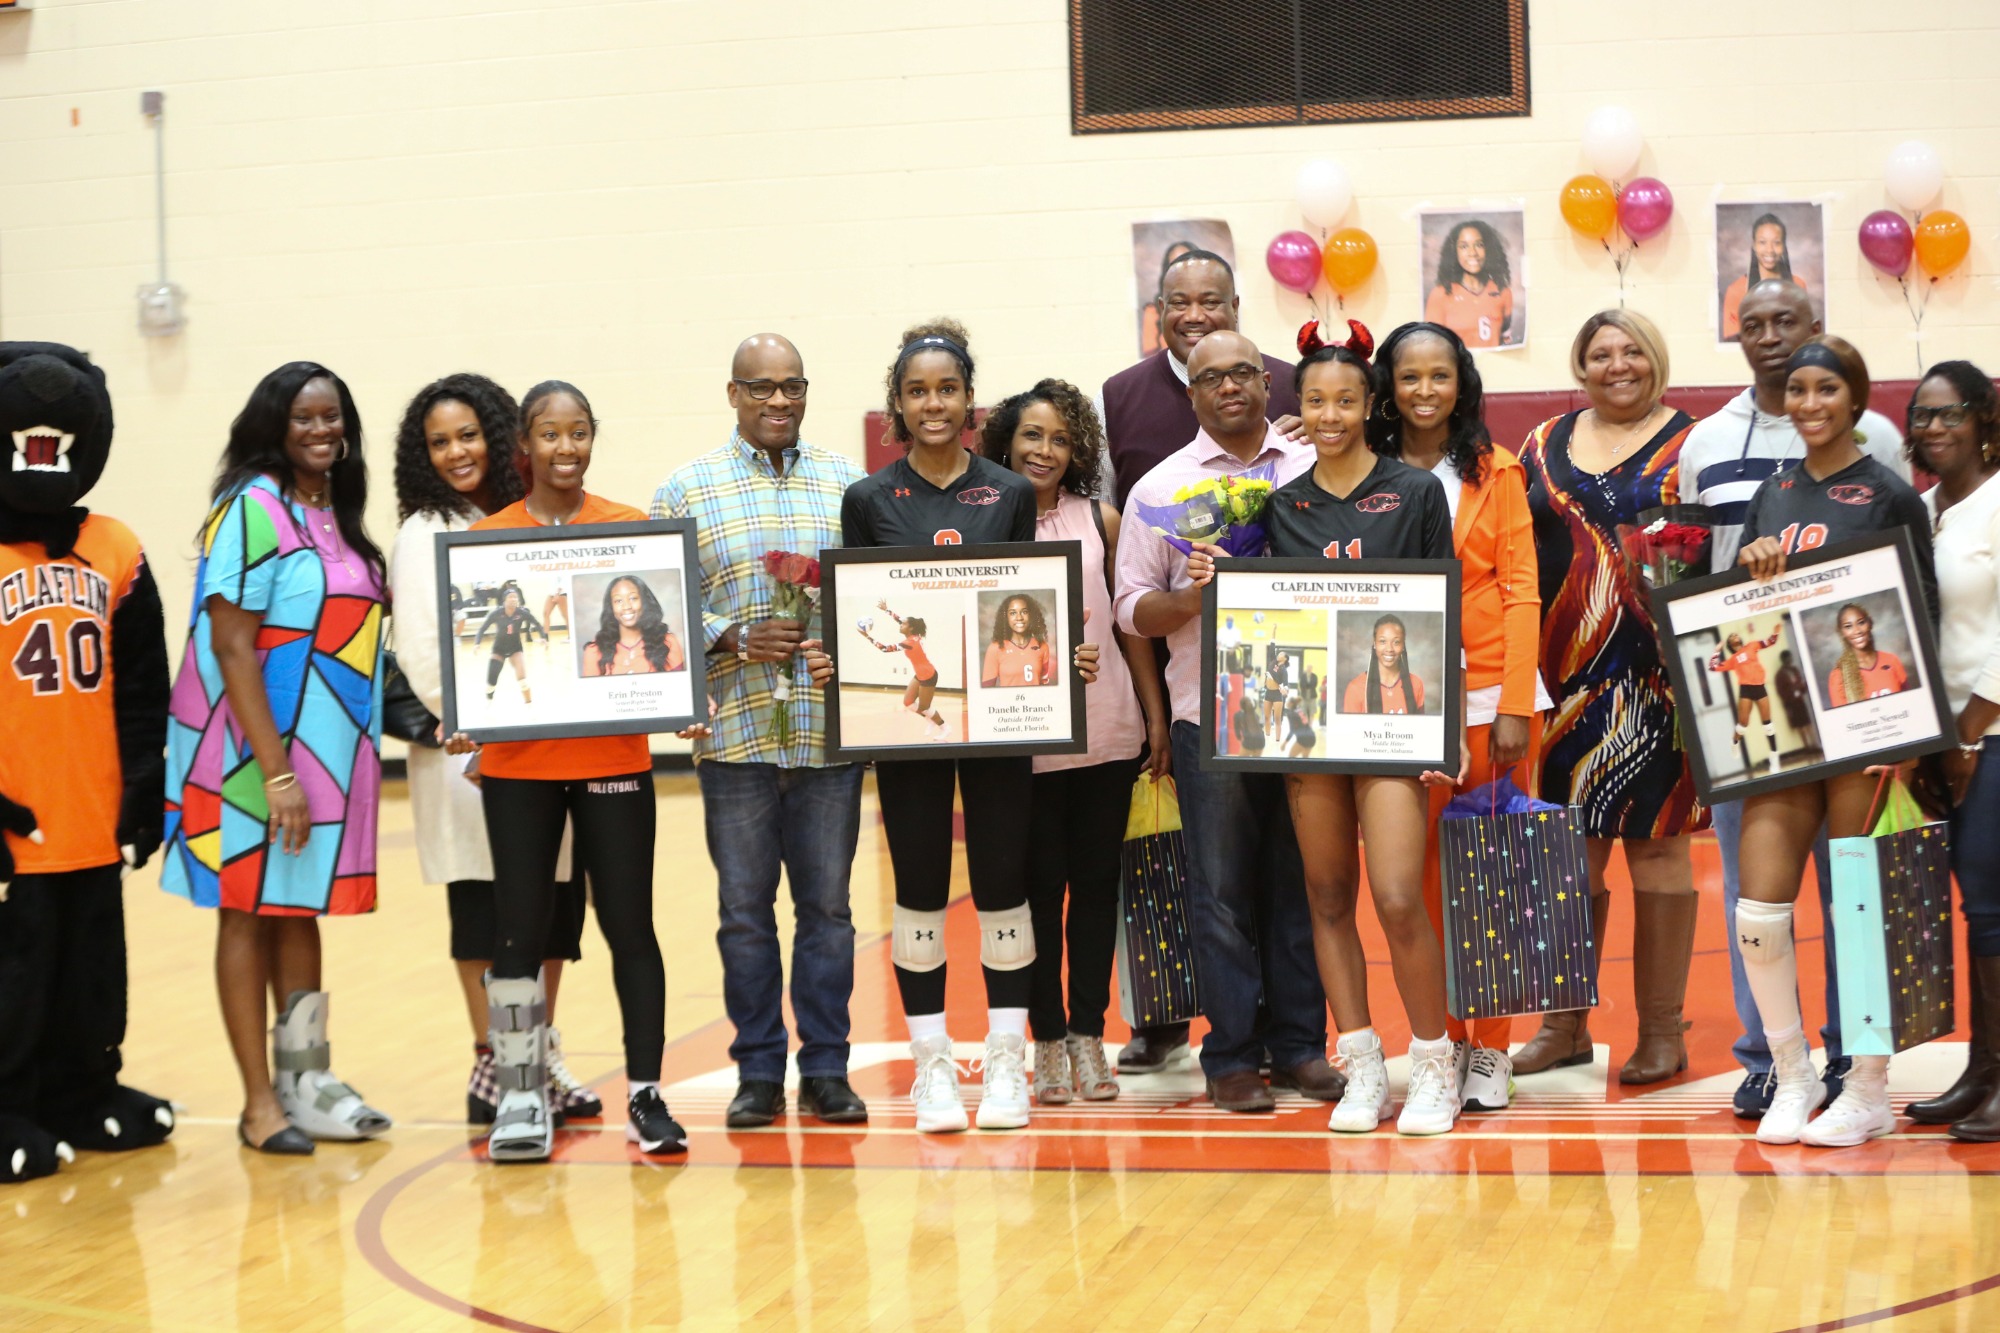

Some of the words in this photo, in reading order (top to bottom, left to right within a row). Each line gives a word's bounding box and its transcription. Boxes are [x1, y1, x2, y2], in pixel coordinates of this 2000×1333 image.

[1479, 315, 1491, 341] 6
[505, 549, 559, 562] CLAFLIN
[562, 545, 637, 559] UNIVERSITY
[889, 567, 943, 579] CLAFLIN
[946, 565, 1020, 577] UNIVERSITY
[911, 579, 999, 590] VOLLEYBALL-2022
[1271, 581, 1324, 592] CLAFLIN
[1327, 582, 1401, 593] UNIVERSITY
[1723, 584, 1776, 606] CLAFLIN
[1778, 565, 1852, 592] UNIVERSITY
[0, 562, 111, 626] CLAFLIN
[11, 618, 103, 696] 40
[1024, 664, 1033, 682] 6
[608, 691, 628, 700] Erin
[630, 690, 663, 698] Preston
[988, 706, 1020, 714] Danelle
[1022, 705, 1053, 713] Branch
[993, 725, 1023, 733] Sanford,
[1363, 731, 1382, 740] Mya
[1385, 731, 1414, 740] Broom
[587, 780, 640, 794] VOLLEYBALL
